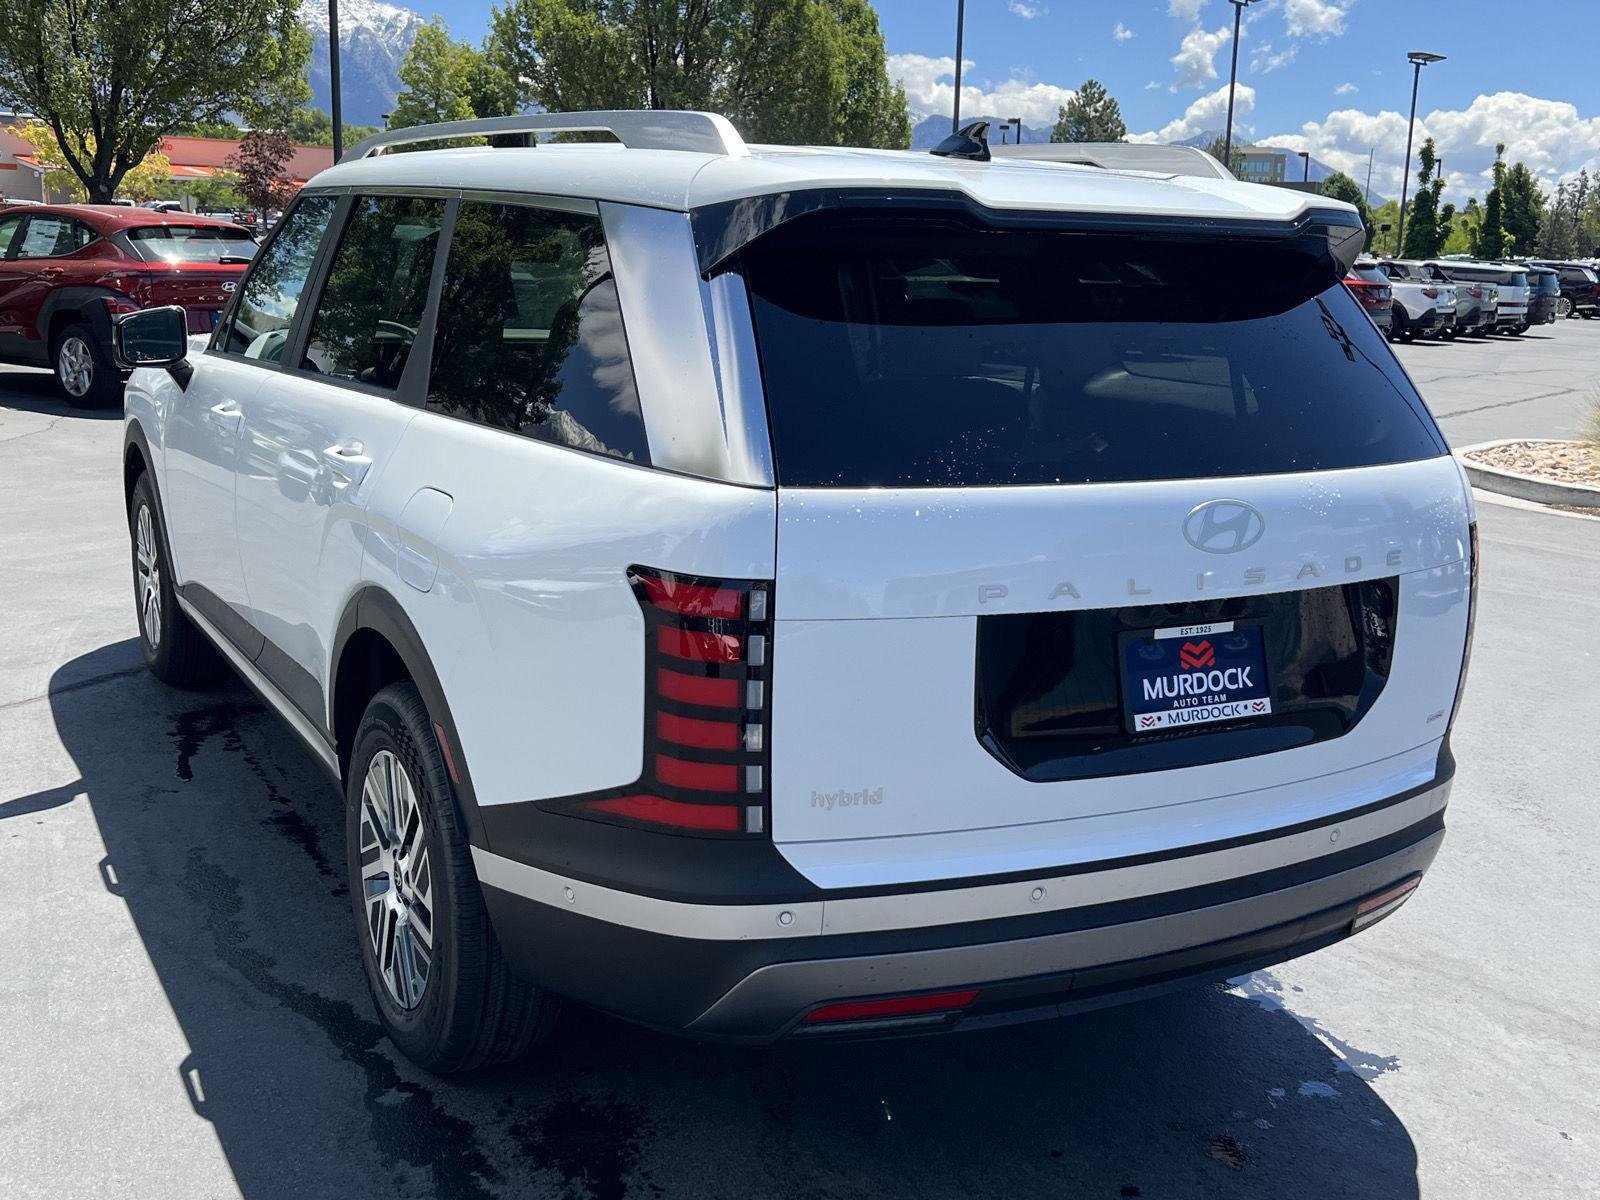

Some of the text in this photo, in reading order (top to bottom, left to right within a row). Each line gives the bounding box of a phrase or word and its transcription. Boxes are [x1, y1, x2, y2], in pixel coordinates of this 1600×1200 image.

[978, 549, 1402, 605] PALISADE
[1180, 625, 1212, 636] EST. 1925
[1142, 666, 1254, 701] MURDOCK
[1173, 693, 1227, 708] AUTO TEAM
[1167, 703, 1242, 725] MURDOCK
[810, 787, 884, 811] hybrid
